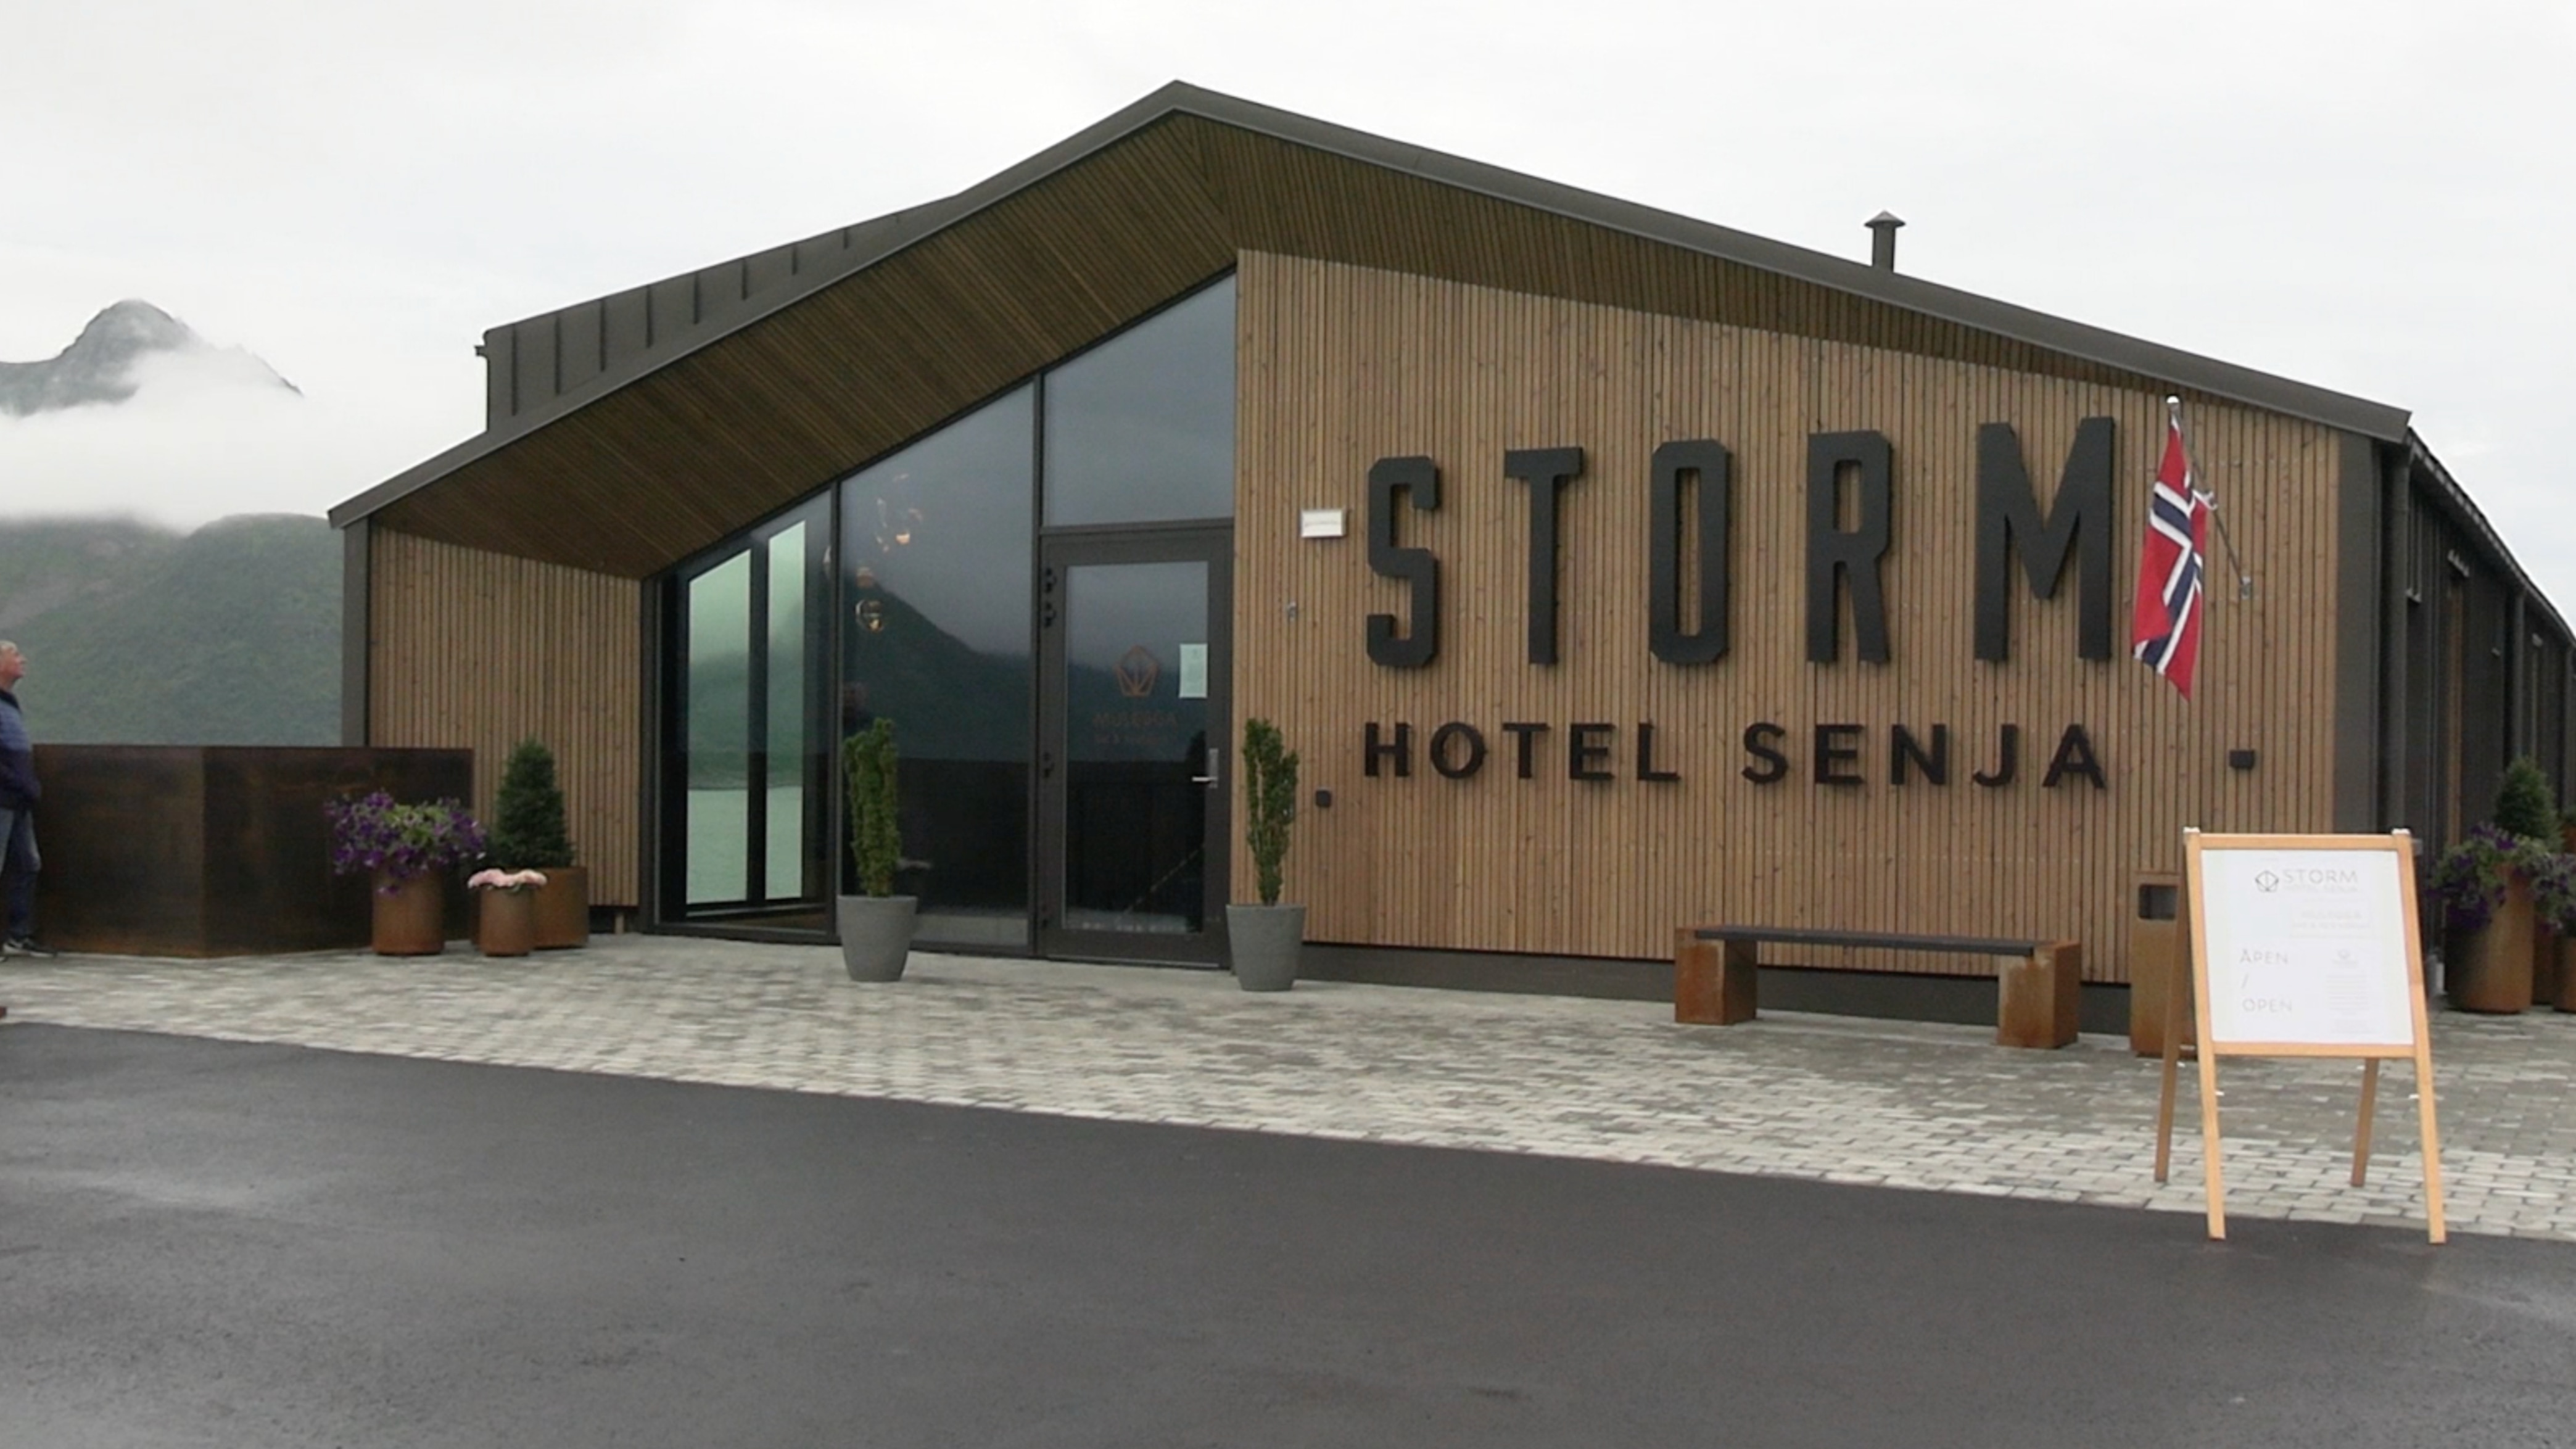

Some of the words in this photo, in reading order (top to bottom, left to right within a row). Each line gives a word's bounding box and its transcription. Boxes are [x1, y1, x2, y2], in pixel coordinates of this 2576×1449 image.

[1366, 416, 2116, 667] STORM
[1364, 721, 1680, 782] HOTEL
[1741, 722, 2106, 790] SENJA
[2282, 869, 2358, 885] STORM
[2239, 948, 2289, 965] ÅPEN
[2242, 997, 2293, 1013] OPEN
